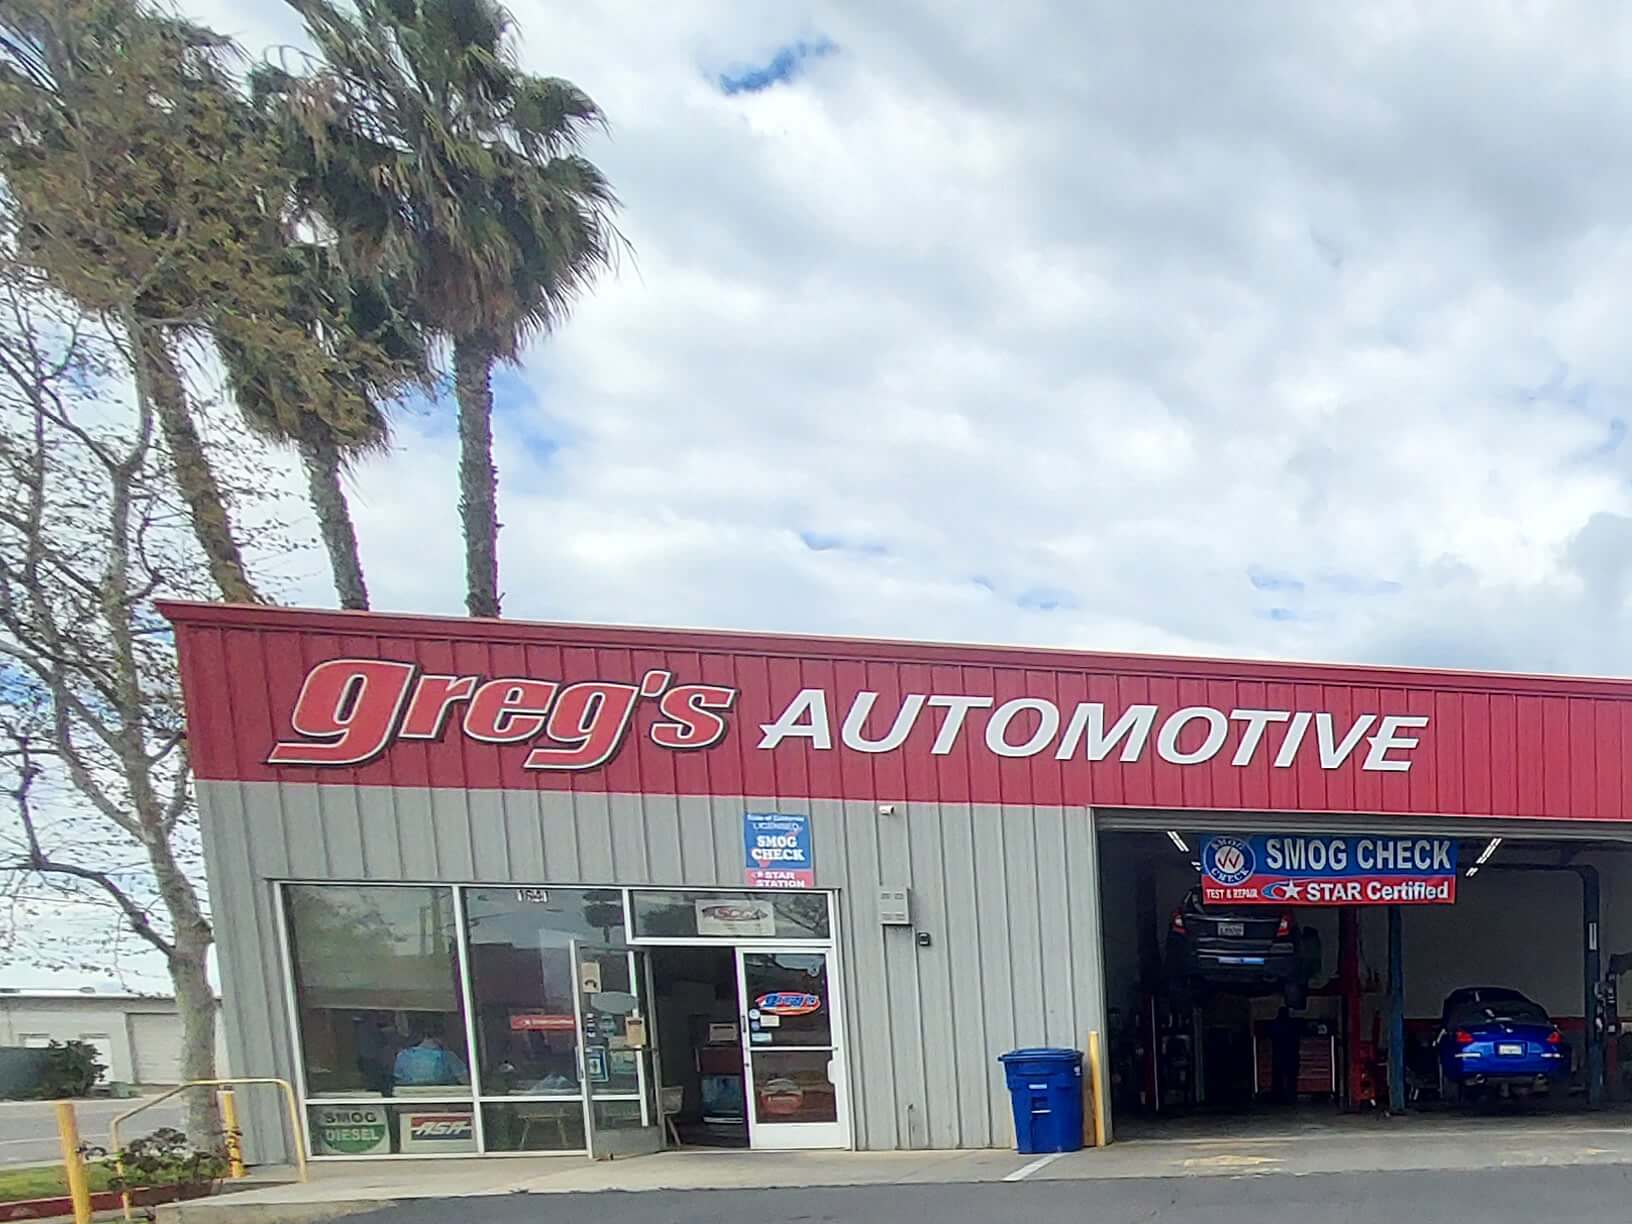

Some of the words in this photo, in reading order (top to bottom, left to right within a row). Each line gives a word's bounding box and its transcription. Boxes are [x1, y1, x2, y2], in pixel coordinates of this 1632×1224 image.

[267, 658, 737, 768] greg's
[758, 688, 1429, 772] AUTOMOTIVE
[756, 835, 798, 848] SMOG
[751, 848, 805, 861] CHECK
[1265, 837, 1348, 870] SMOG
[1356, 838, 1452, 870] CHECK
[765, 871, 795, 879] STAR
[1210, 867, 1250, 883] CHECK
[755, 879, 805, 888] STATION
[1206, 888, 1225, 899] TEST
[1306, 882, 1362, 901] STAR
[1366, 880, 1449, 900] Certified
[325, 1111, 378, 1124] SMOG
[325, 1128, 380, 1142] DIESEL
